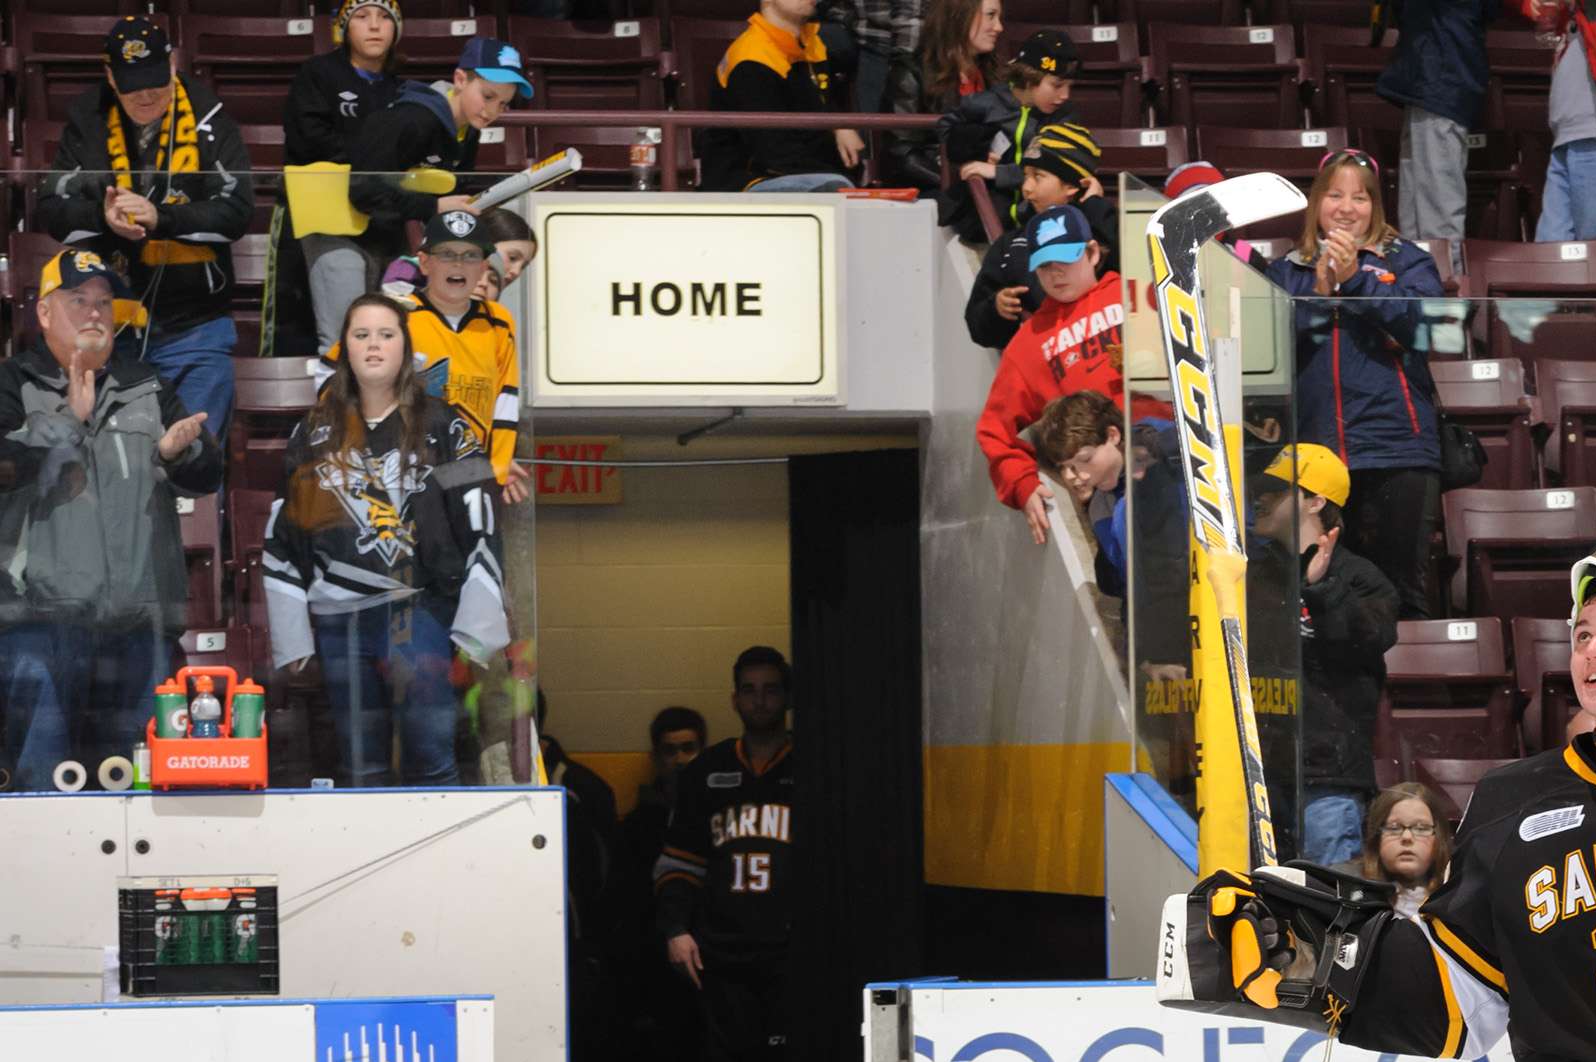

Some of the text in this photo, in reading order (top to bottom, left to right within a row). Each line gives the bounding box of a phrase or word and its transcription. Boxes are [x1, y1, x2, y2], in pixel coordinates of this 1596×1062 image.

[1149, 134, 1160, 142] 11
[1309, 135, 1320, 143] 12
[611, 282, 763, 317] HOME
[1041, 303, 1125, 362] CANAD
[1163, 281, 1228, 520] CCM
[535, 444, 607, 494] EXIT
[1555, 496, 1566, 504] 12
[1456, 626, 1468, 635] 11
[167, 755, 250, 769] GATORADE
[711, 802, 791, 847] SARNI
[732, 853, 771, 892] 15
[1163, 922, 1176, 979] CCM
